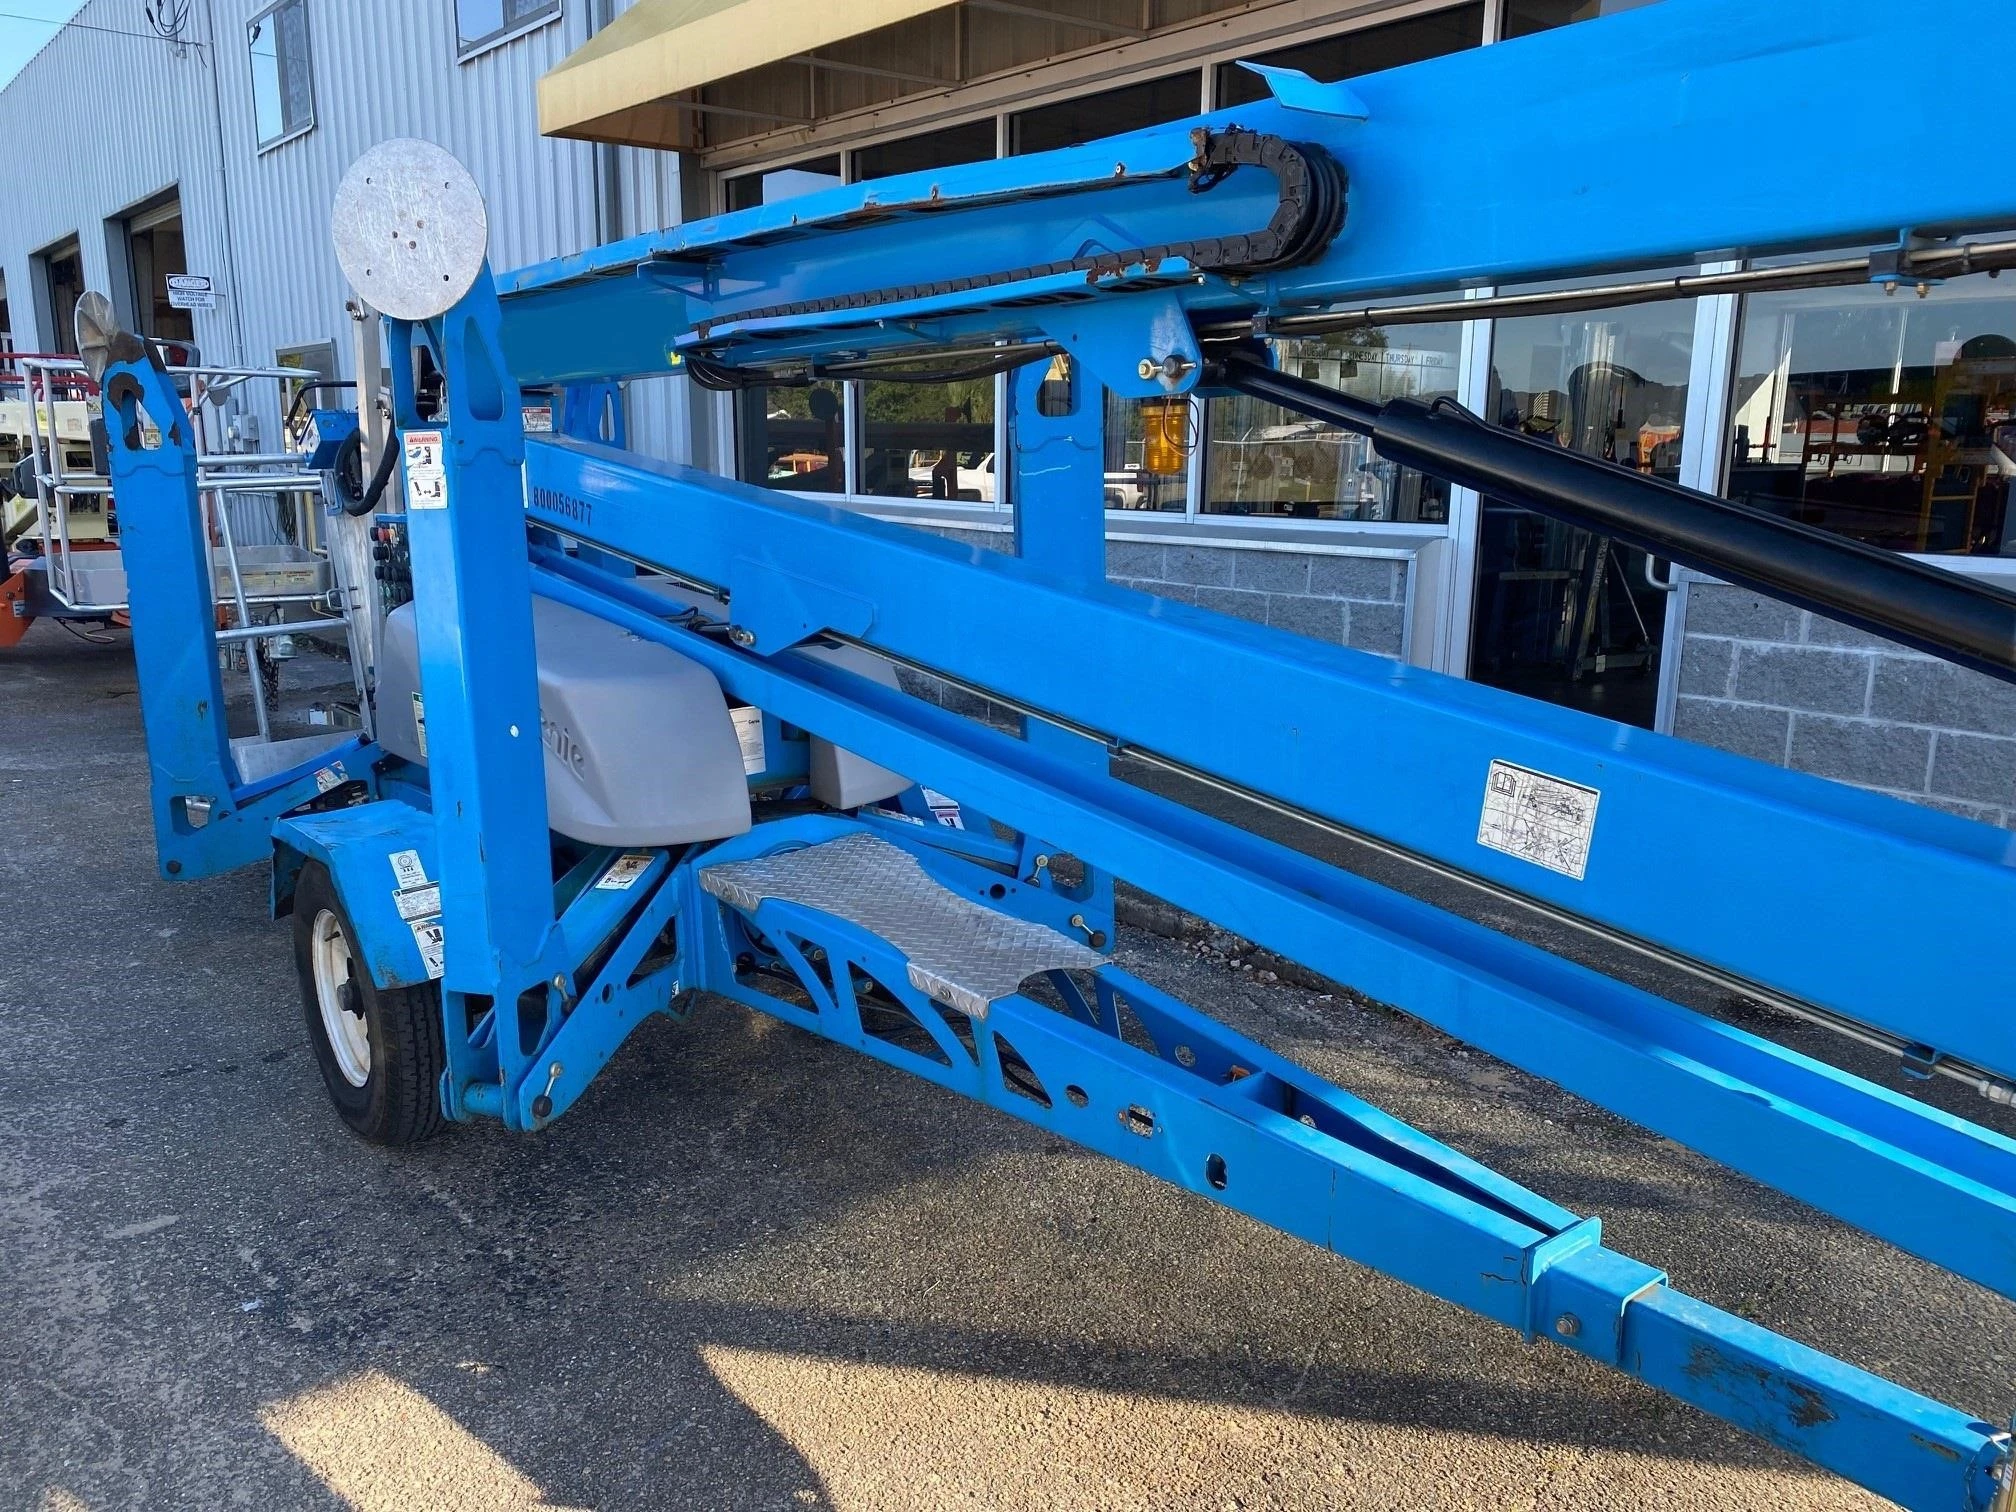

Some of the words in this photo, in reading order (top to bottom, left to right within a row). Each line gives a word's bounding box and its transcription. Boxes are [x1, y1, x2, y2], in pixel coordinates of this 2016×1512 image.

[1386, 353, 1415, 364] THURSDAY
[1425, 355, 1444, 366] FRIDAY
[533, 486, 592, 527] 800056877
